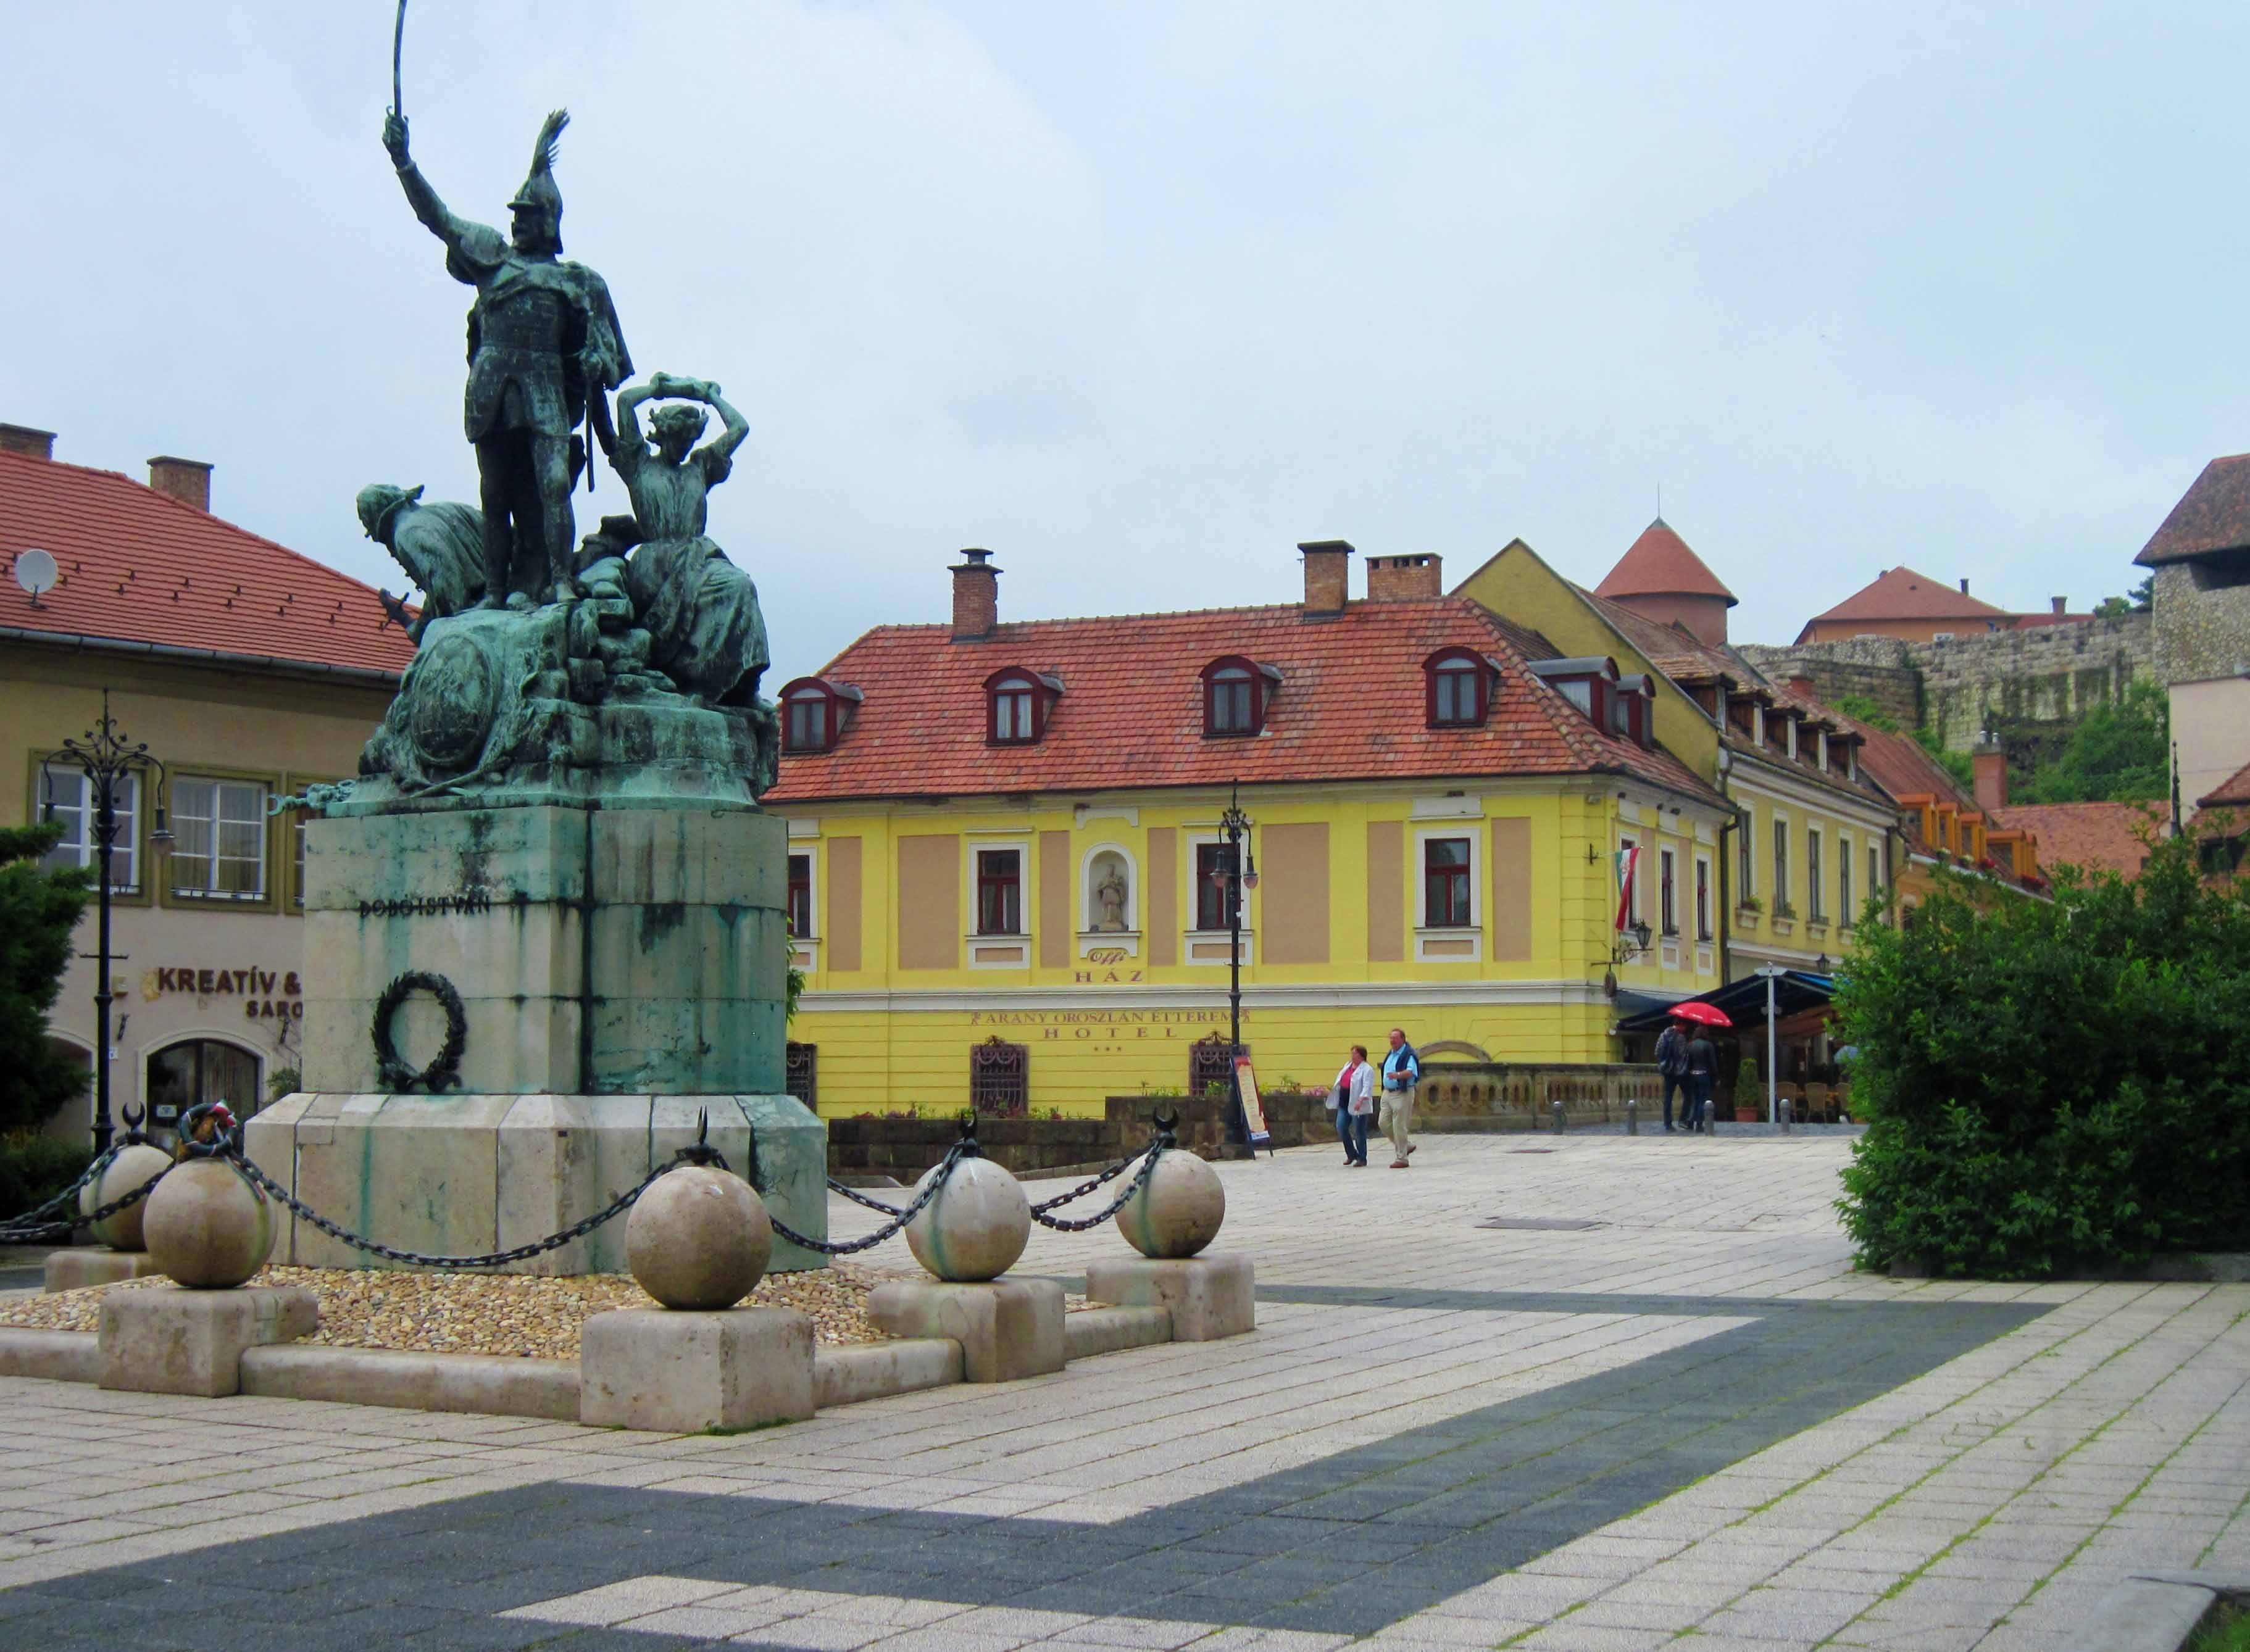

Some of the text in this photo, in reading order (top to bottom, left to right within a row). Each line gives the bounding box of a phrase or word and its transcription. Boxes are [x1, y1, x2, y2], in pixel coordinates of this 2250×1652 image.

[1090, 952, 1127, 965] Offi
[159, 965, 302, 995] KREATÍV &
[1075, 968, 1142, 983] HÁZ
[987, 1012, 1047, 1024] ARANY
[1044, 1027, 1177, 1039] HOTEL
